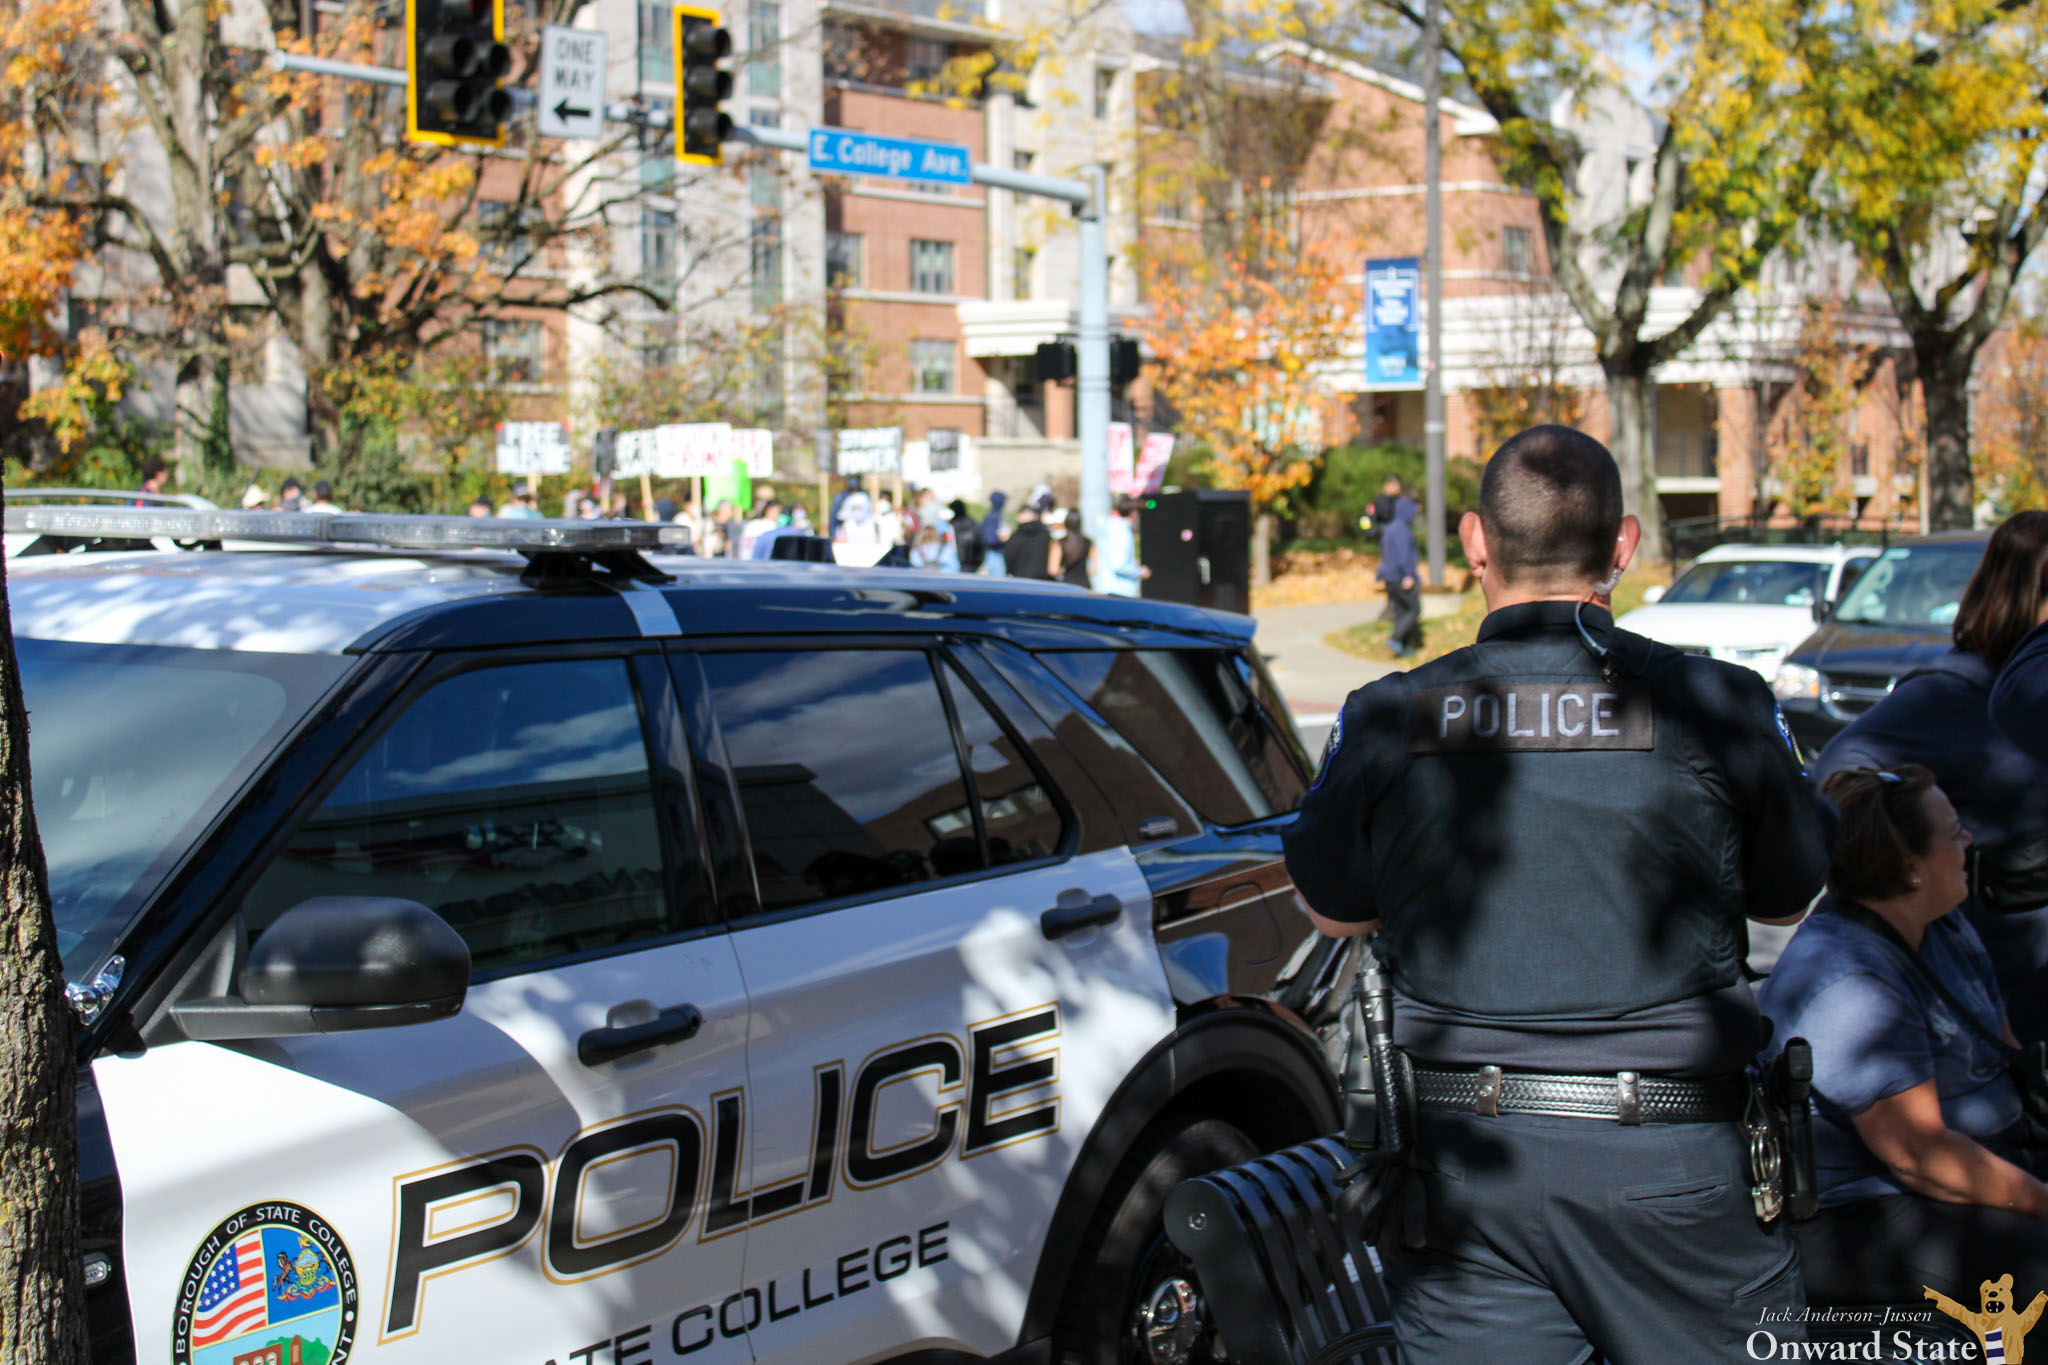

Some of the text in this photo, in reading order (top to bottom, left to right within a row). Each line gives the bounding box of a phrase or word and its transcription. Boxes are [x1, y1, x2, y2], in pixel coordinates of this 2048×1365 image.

[555, 37, 595, 65] ONE
[553, 65, 597, 92] WAY
[837, 136, 913, 176] College
[920, 147, 969, 176] Ave.
[1439, 691, 1620, 739] POLICE
[380, 1003, 1060, 1343] POLICE
[175, 1205, 357, 1354] BOROUGH OF STATE COLLEGE
[671, 1220, 950, 1356] COLLEGE
